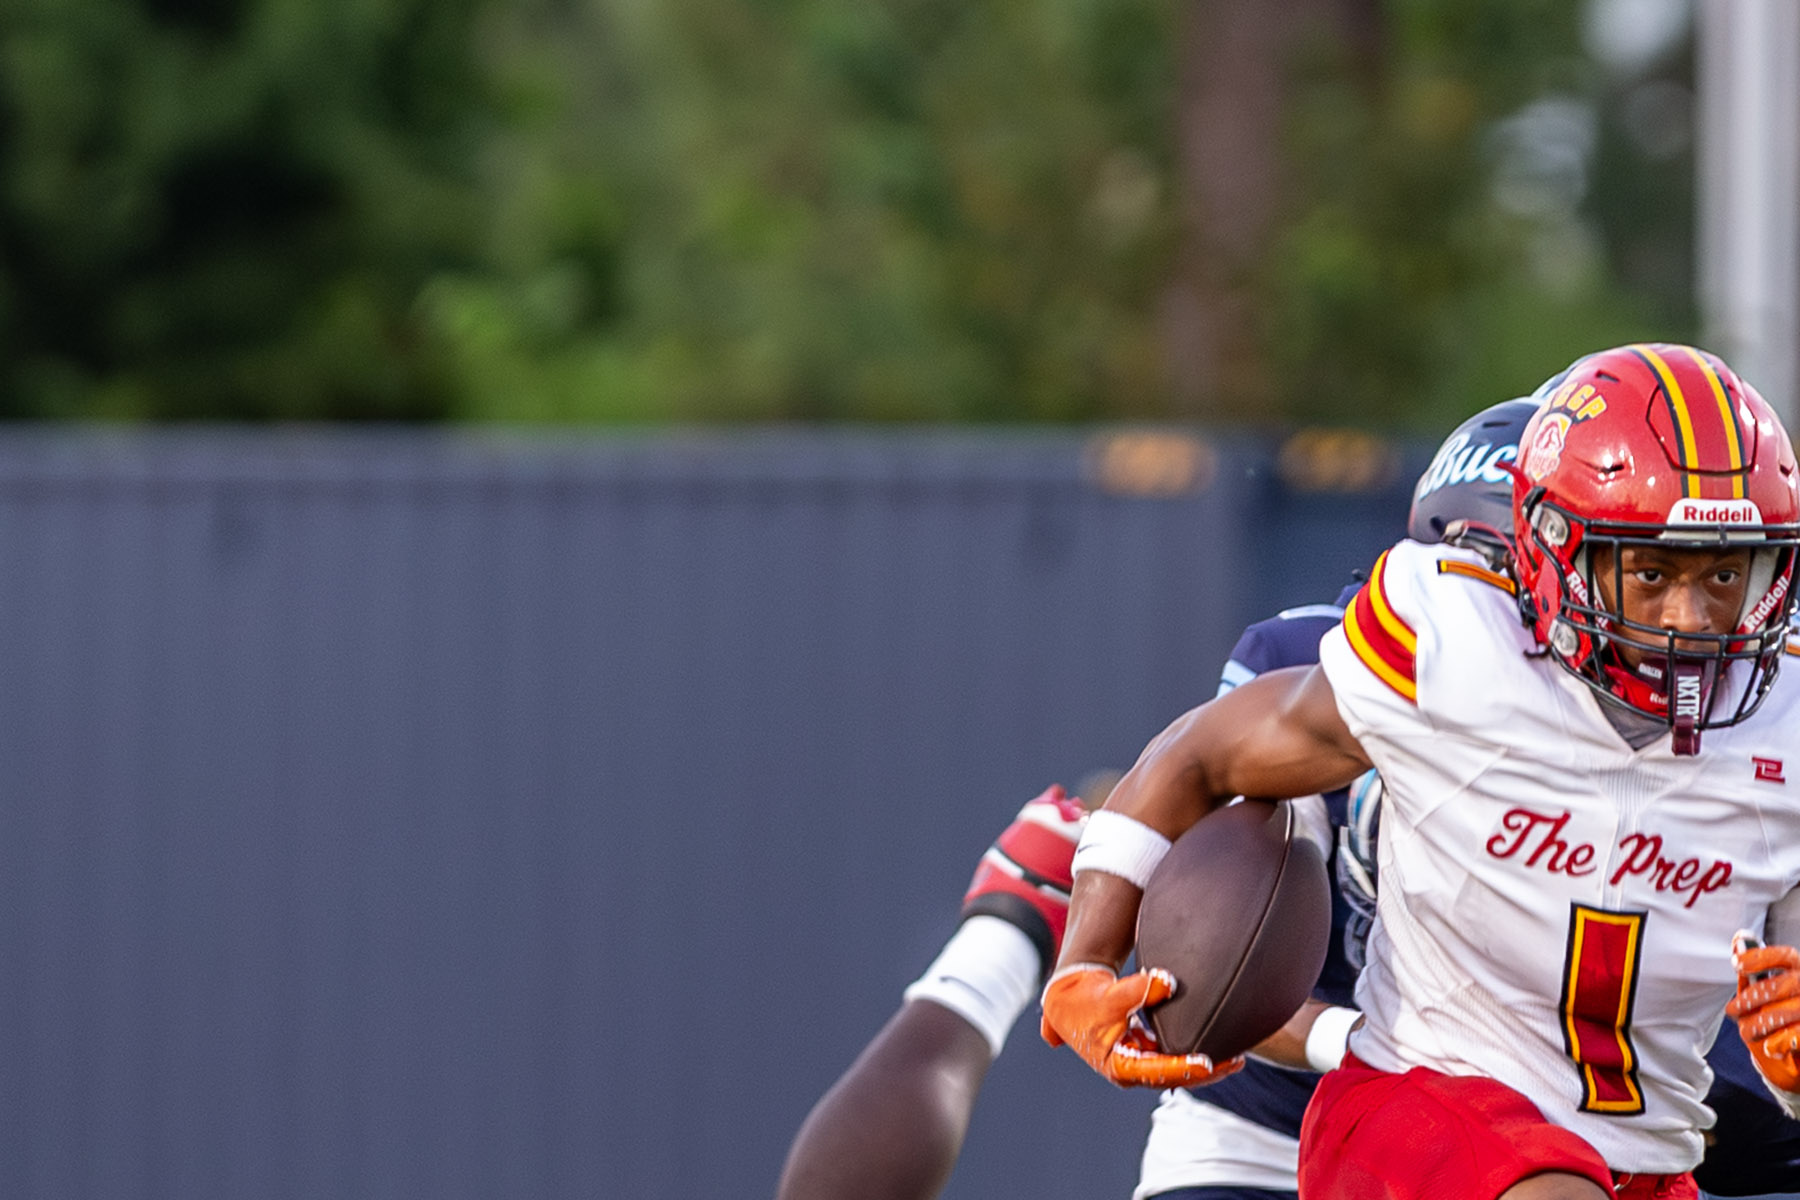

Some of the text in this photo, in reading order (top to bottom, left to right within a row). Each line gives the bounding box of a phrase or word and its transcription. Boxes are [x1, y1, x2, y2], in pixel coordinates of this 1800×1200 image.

[1418, 432, 1519, 501] Buc
[1683, 505, 1753, 523] Riddell
[1743, 575, 1790, 631] Riddell
[1677, 675, 1701, 718] NXTR
[1485, 807, 1733, 909] The Prep
[1559, 900, 1649, 1116] 1
